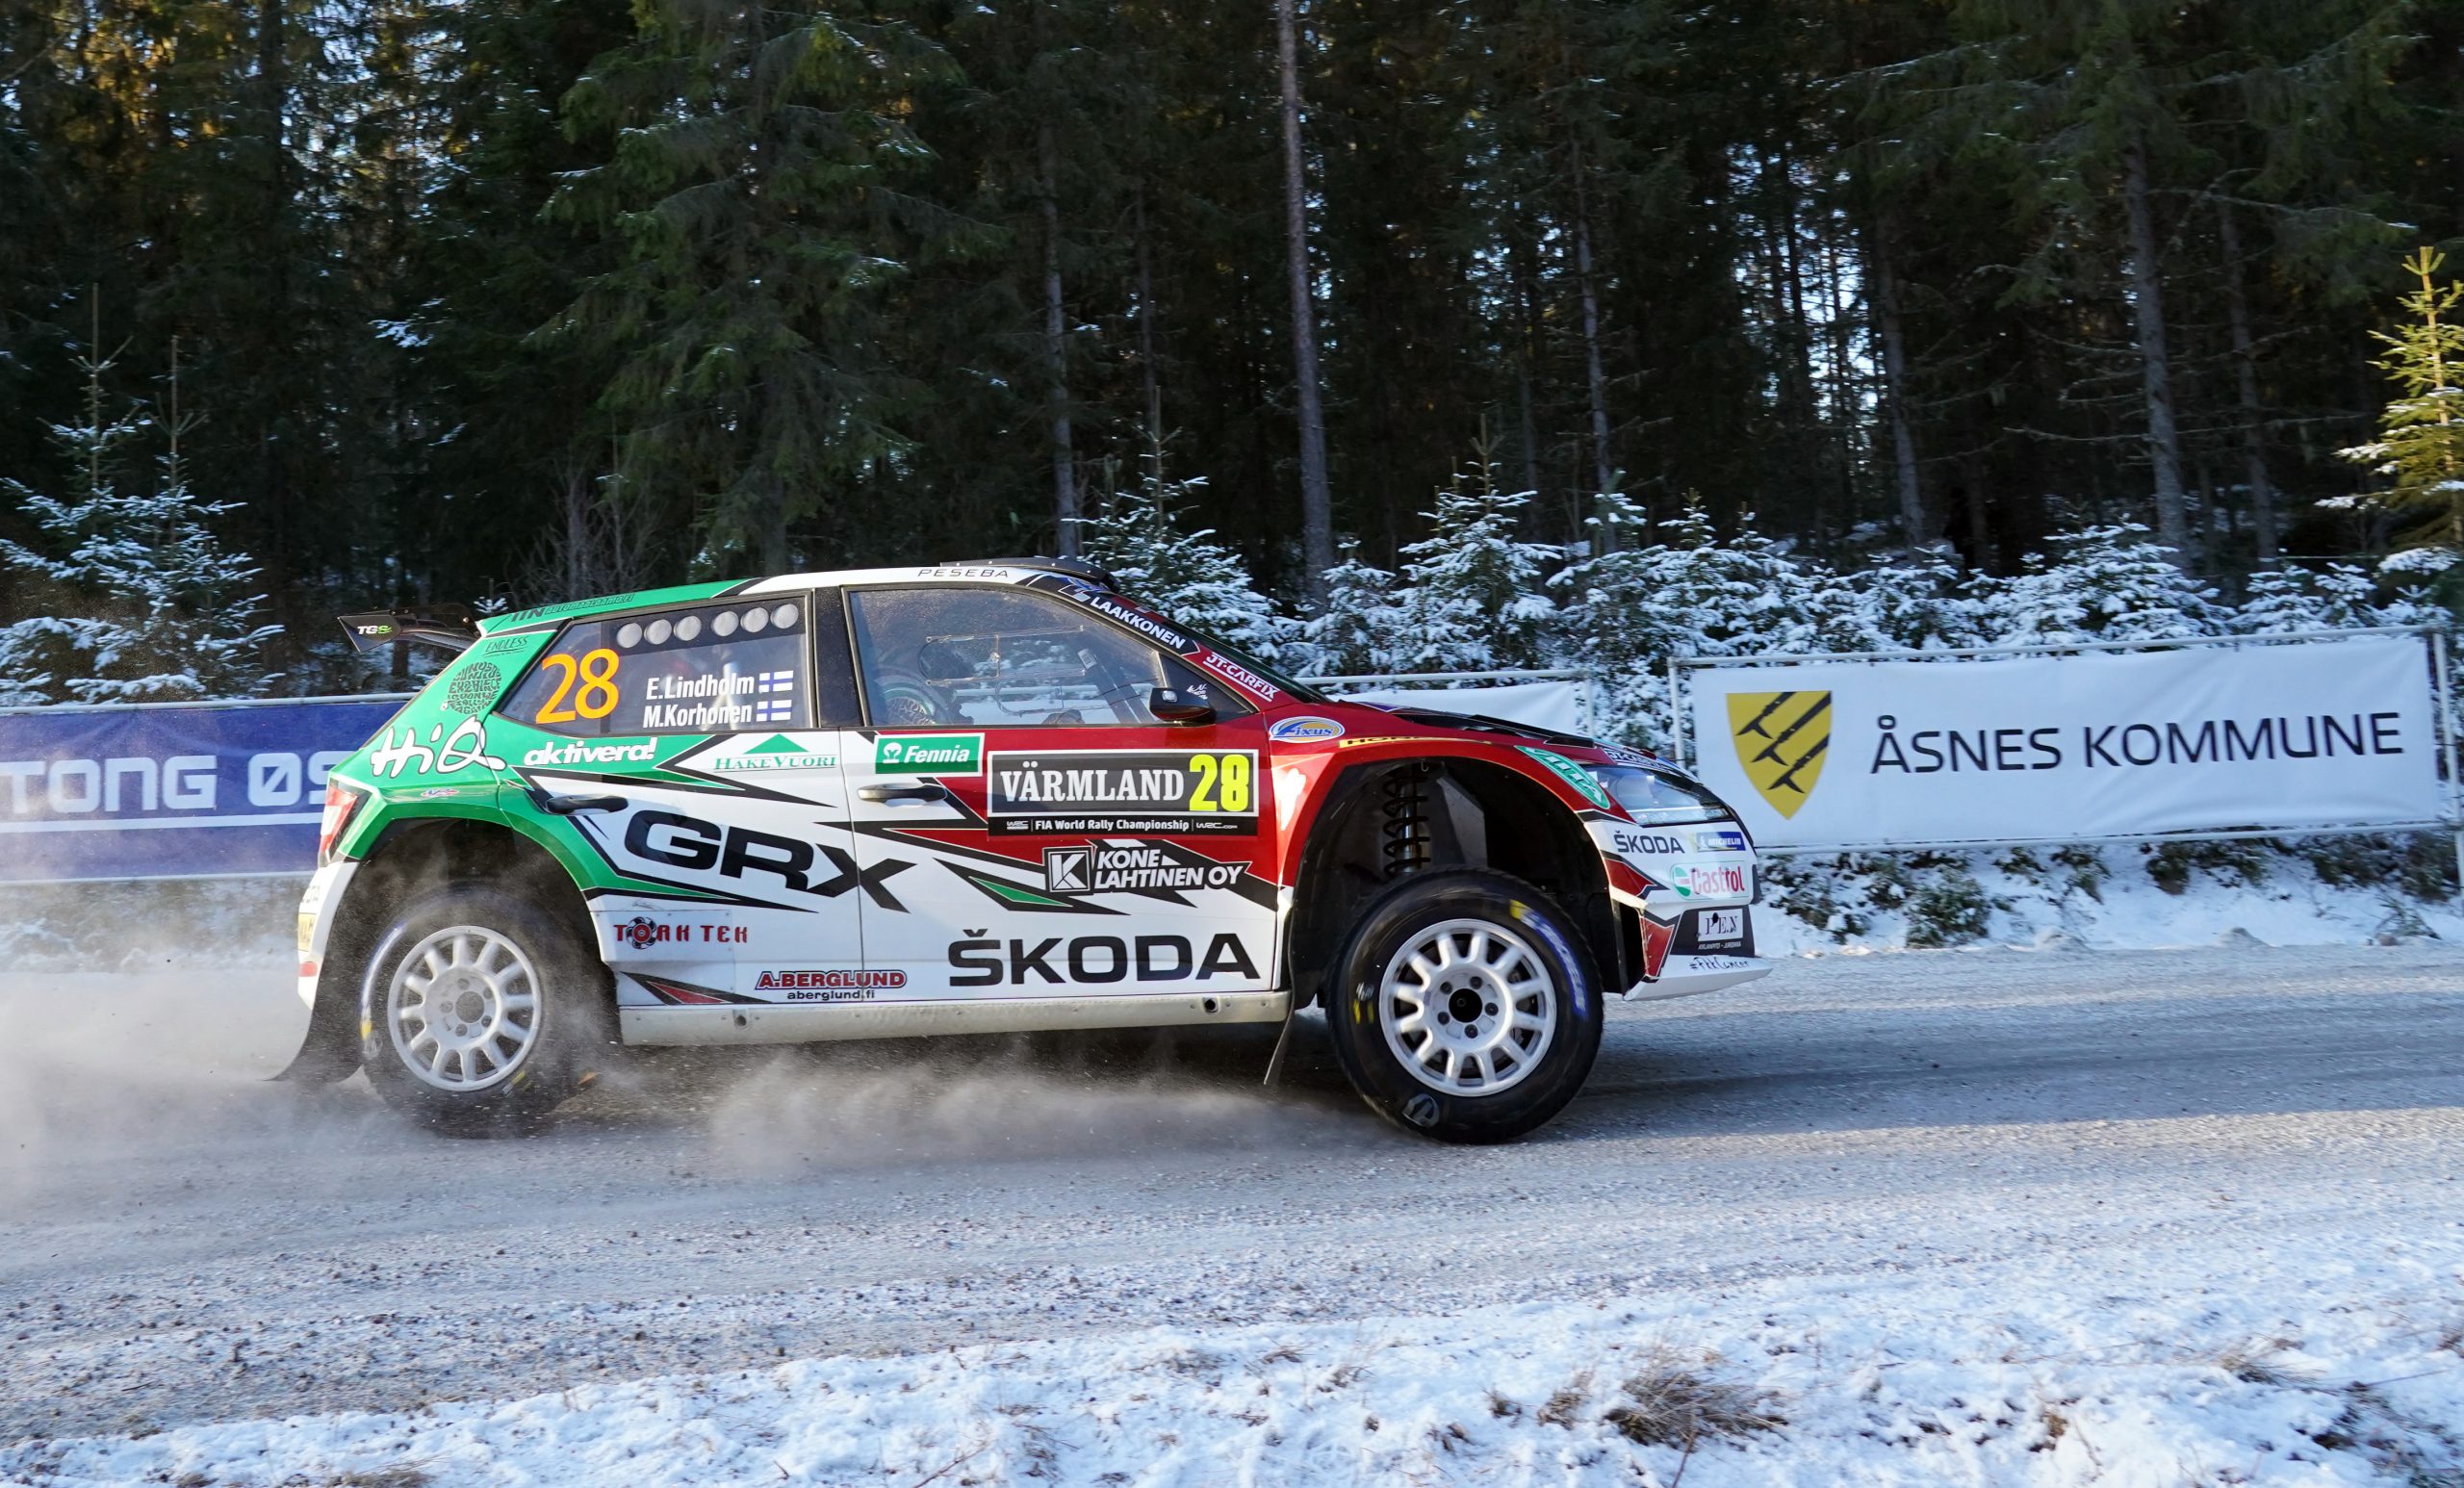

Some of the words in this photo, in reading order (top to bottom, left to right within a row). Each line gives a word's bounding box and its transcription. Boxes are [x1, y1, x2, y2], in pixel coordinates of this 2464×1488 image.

[916, 569, 1009, 578] PESEBA
[1090, 596, 1187, 650] LAAKKONEN
[535, 647, 620, 725] 28
[646, 675, 755, 701] E.Lindholm
[642, 704, 753, 729] M.Korhonen
[524, 736, 658, 767] aktivera!
[903, 745, 970, 764] Fennia
[1870, 713, 2062, 774] ÅSNES
[2085, 711, 2405, 769] KOMMUNE
[999, 760, 1185, 803] VÄRMLAND
[1189, 754, 1250, 812] 28
[1035, 820, 1053, 831] FIA
[1054, 819, 1086, 830] World
[1087, 819, 1115, 832] Rally
[1116, 818, 1190, 832] Championship
[1614, 830, 1685, 855] ŠKODA
[1707, 835, 1742, 847] MICHELIN
[624, 809, 918, 914] GRX
[1095, 848, 1162, 870] KONE
[1093, 866, 1204, 890] LAHTINEN
[1207, 865, 1245, 886] OY
[1690, 865, 1746, 896] Castrol
[700, 925, 748, 944] TEK
[948, 928, 1262, 988] ŠKODA
[757, 970, 906, 988] A.BERGLUND
[786, 989, 875, 1001] aberglund.fi
